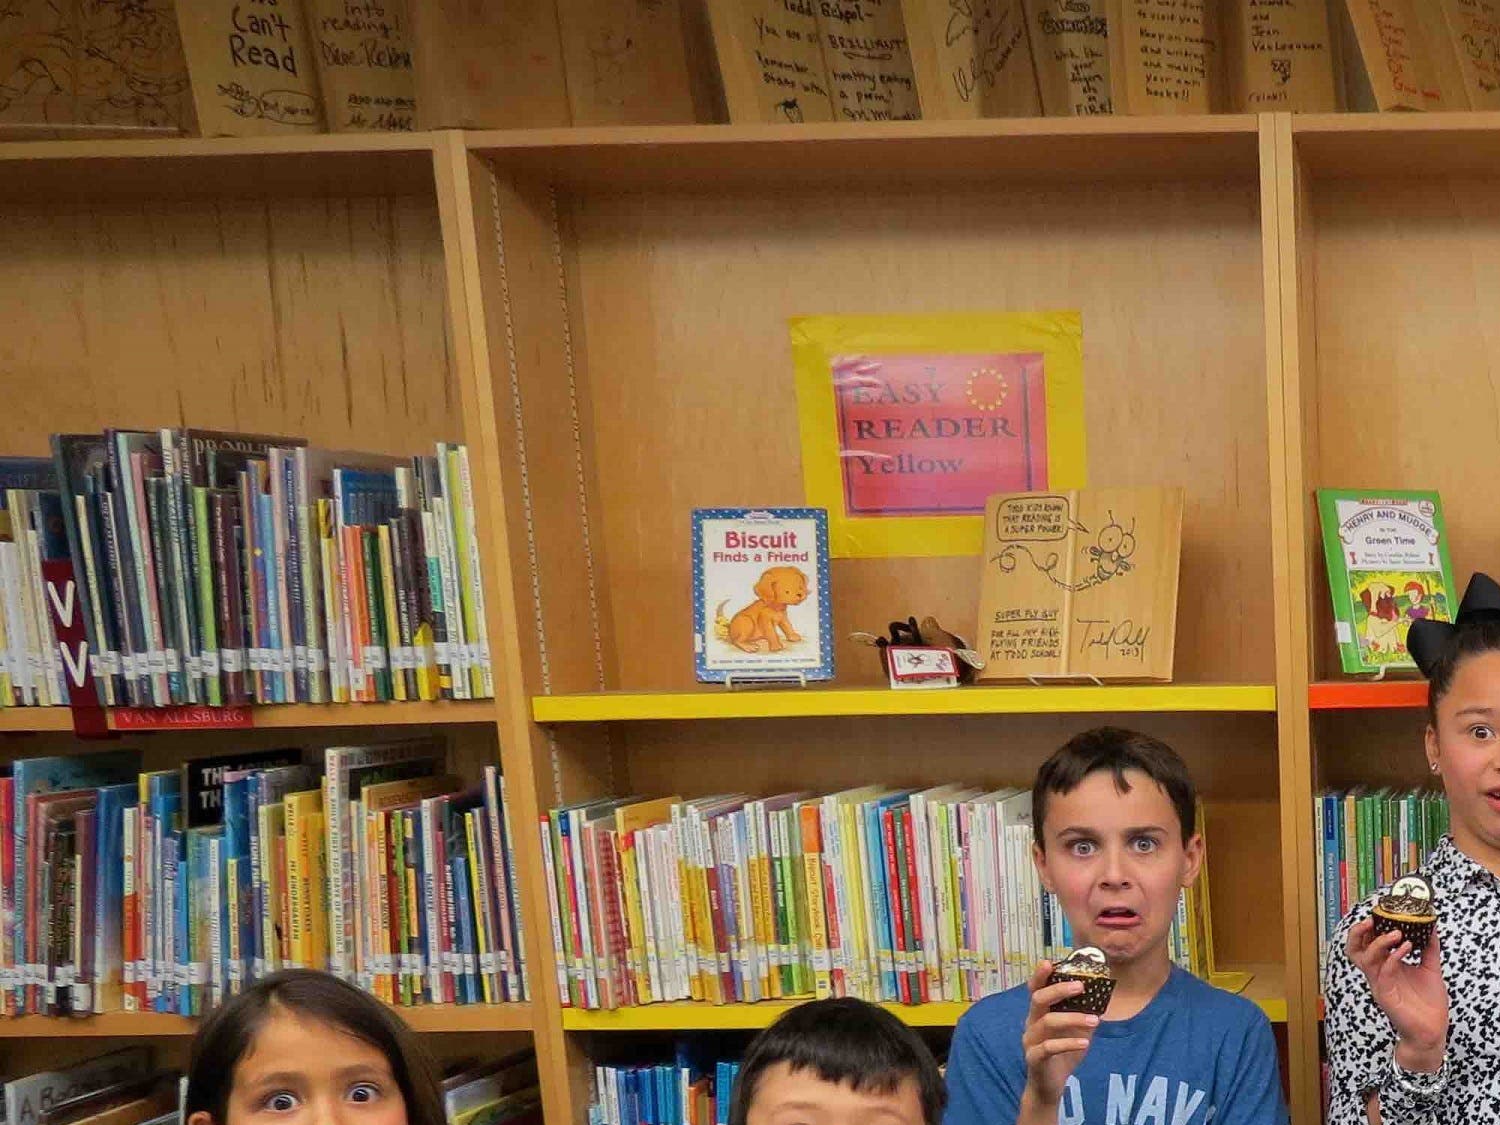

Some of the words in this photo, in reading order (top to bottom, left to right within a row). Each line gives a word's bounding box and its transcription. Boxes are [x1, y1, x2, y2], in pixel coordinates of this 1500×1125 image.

[232, 6, 292, 41] Can't
[230, 34, 298, 78] Read
[852, 383, 946, 405] EASY
[852, 417, 1019, 440] READER
[857, 454, 965, 475] Yellow
[1345, 510, 1375, 533] HENRY
[1377, 510, 1396, 520] AND
[1399, 513, 1433, 538] MUDGE
[725, 531, 797, 549] Biscuit
[1365, 536, 1392, 546] Green
[1394, 535, 1416, 546] Time
[713, 552, 749, 562] Finds
[753, 553, 762, 562] a
[47, 580, 76, 628] V
[995, 609, 1020, 621] SUPER
[1025, 609, 1039, 619] FLY
[990, 639, 1018, 649] FLYING
[1022, 638, 1060, 648] FRIENDS
[60, 641, 89, 688] V
[990, 649, 1001, 660] AT
[1004, 649, 1028, 660] TODD
[120, 711, 156, 725] VAN
[166, 709, 245, 725] ALLSBURG
